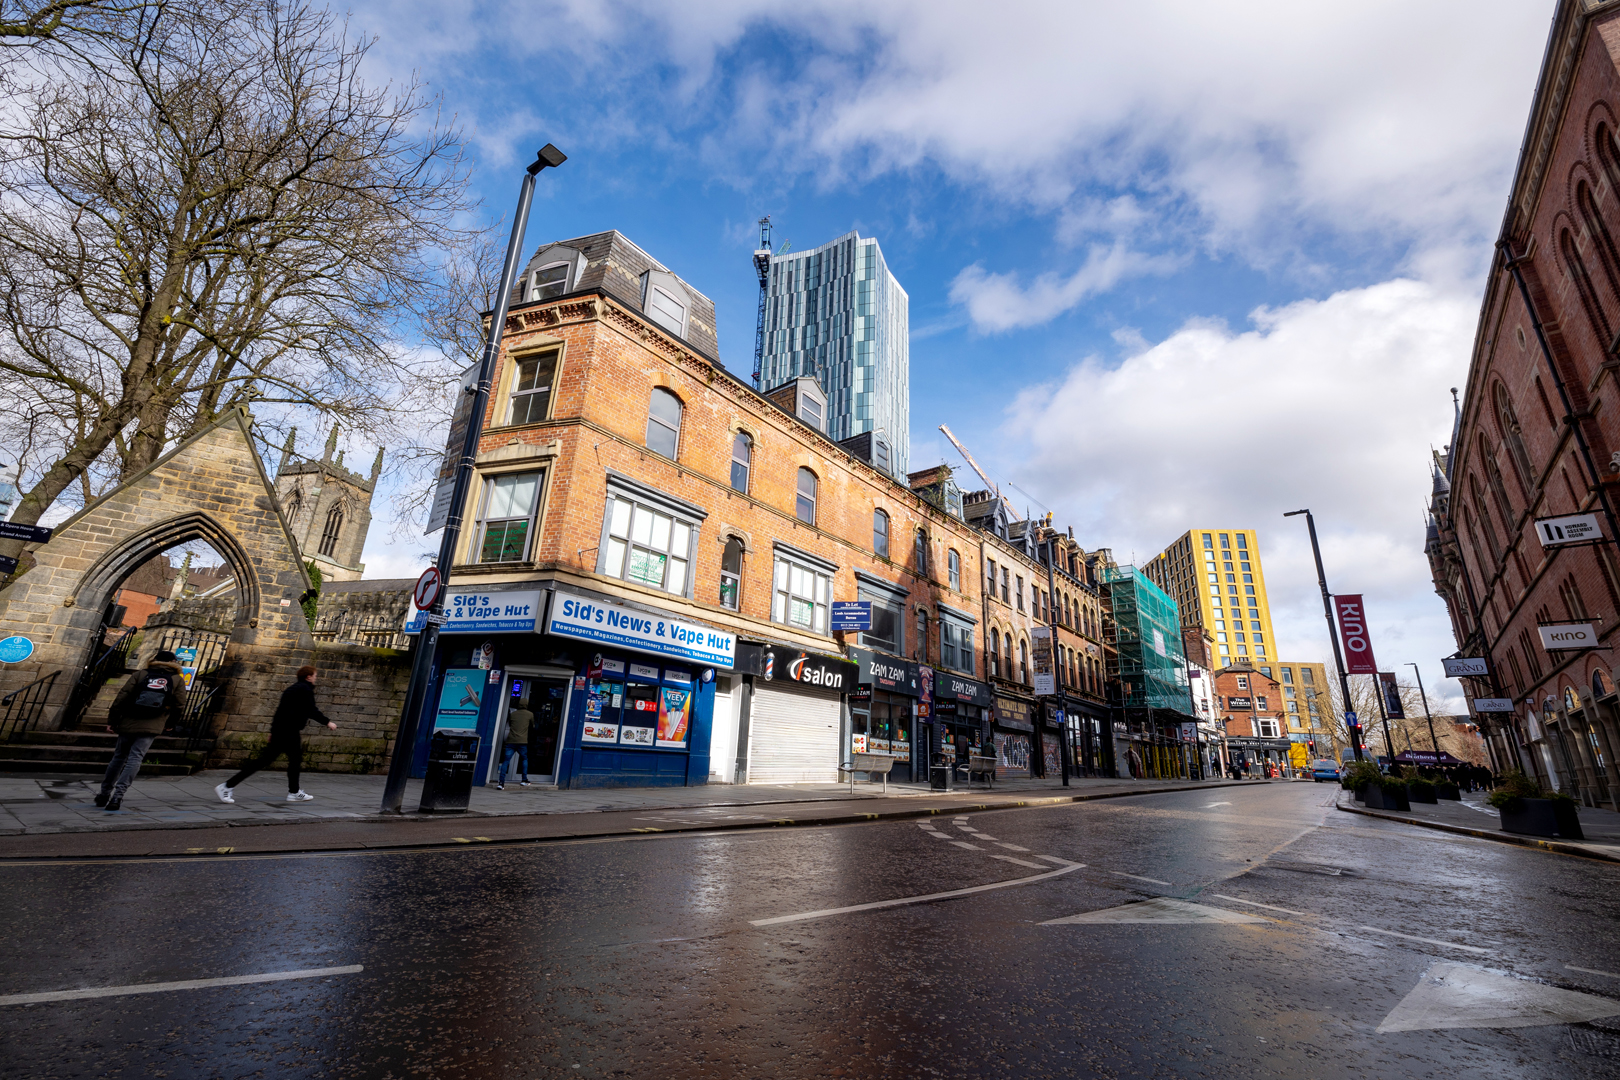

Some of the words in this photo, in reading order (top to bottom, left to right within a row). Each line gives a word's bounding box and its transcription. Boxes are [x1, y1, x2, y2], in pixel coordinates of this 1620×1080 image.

[454, 595, 489, 606] Sid's
[455, 607, 463, 618] &
[468, 607, 500, 619] Vape
[504, 604, 530, 616] Hut
[563, 599, 604, 623] Sid's
[607, 609, 651, 634] News
[656, 621, 665, 637] &
[670, 624, 704, 645] Vape
[707, 633, 731, 651] Hut
[555, 623, 593, 636] Newspapers,
[594, 631, 625, 642] Magazines,
[663, 645, 691, 656] Sandwiches,
[692, 651, 711, 659] Tobacco
[870, 661, 886, 678] ZAM
[888, 666, 904, 682] ZAM
[1448, 664, 1484, 673] GRAND
[952, 680, 964, 693] ZAM
[965, 684, 977, 696] ZAM
[667, 692, 685, 701] VEEV
